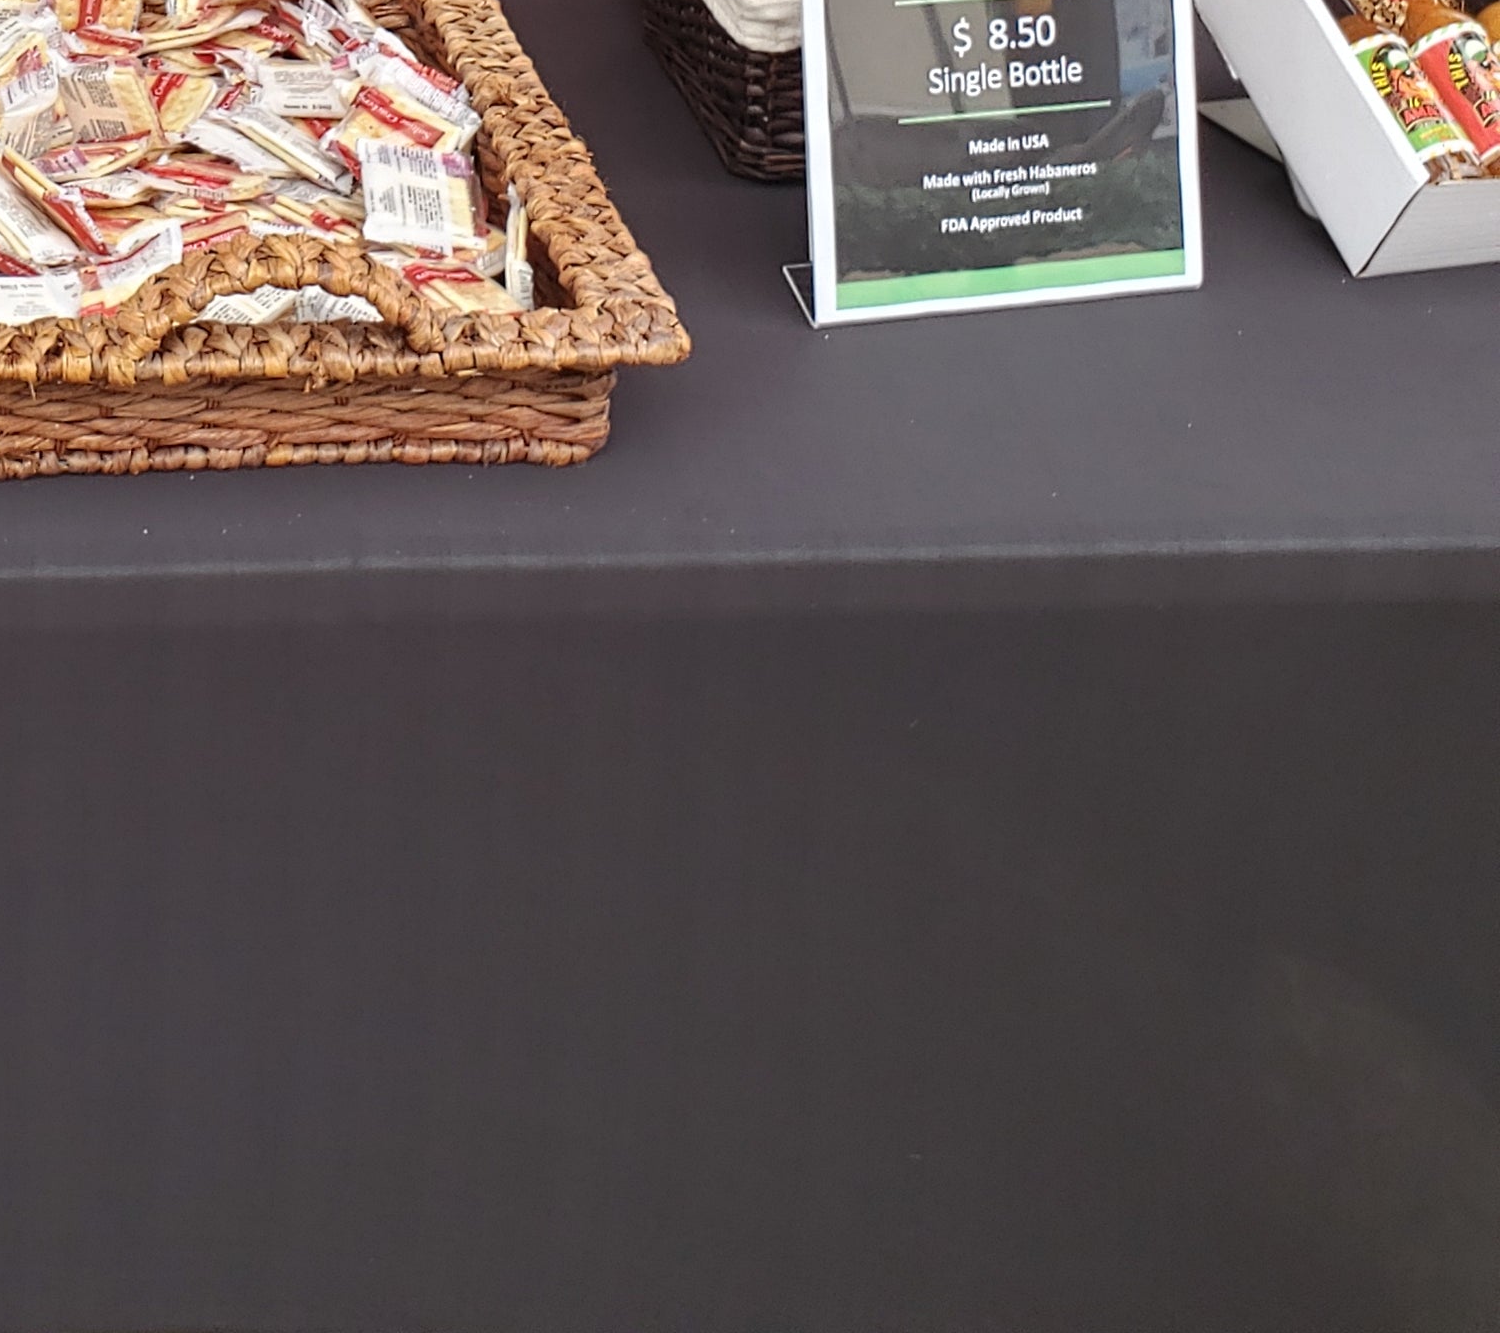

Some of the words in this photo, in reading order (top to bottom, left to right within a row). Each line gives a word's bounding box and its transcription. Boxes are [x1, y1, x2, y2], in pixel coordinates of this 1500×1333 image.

[953, 16, 972, 58] $
[988, 14, 1056, 50] 8.50
[928, 62, 1002, 97] Single
[1009, 55, 1083, 87] Bottle
[1372, 62, 1392, 97] THIS
[1448, 53, 1469, 91] THIS
[968, 137, 1006, 155] Made
[1021, 133, 1049, 149] USA
[922, 172, 961, 190] Made
[962, 171, 992, 187] with
[993, 166, 1027, 184] Fresh
[1029, 162, 1097, 180] Habaneros
[971, 187, 1010, 203] (Locally
[941, 218, 969, 233] FDA
[970, 210, 1031, 233] Approved
[1032, 206, 1083, 224] Product
